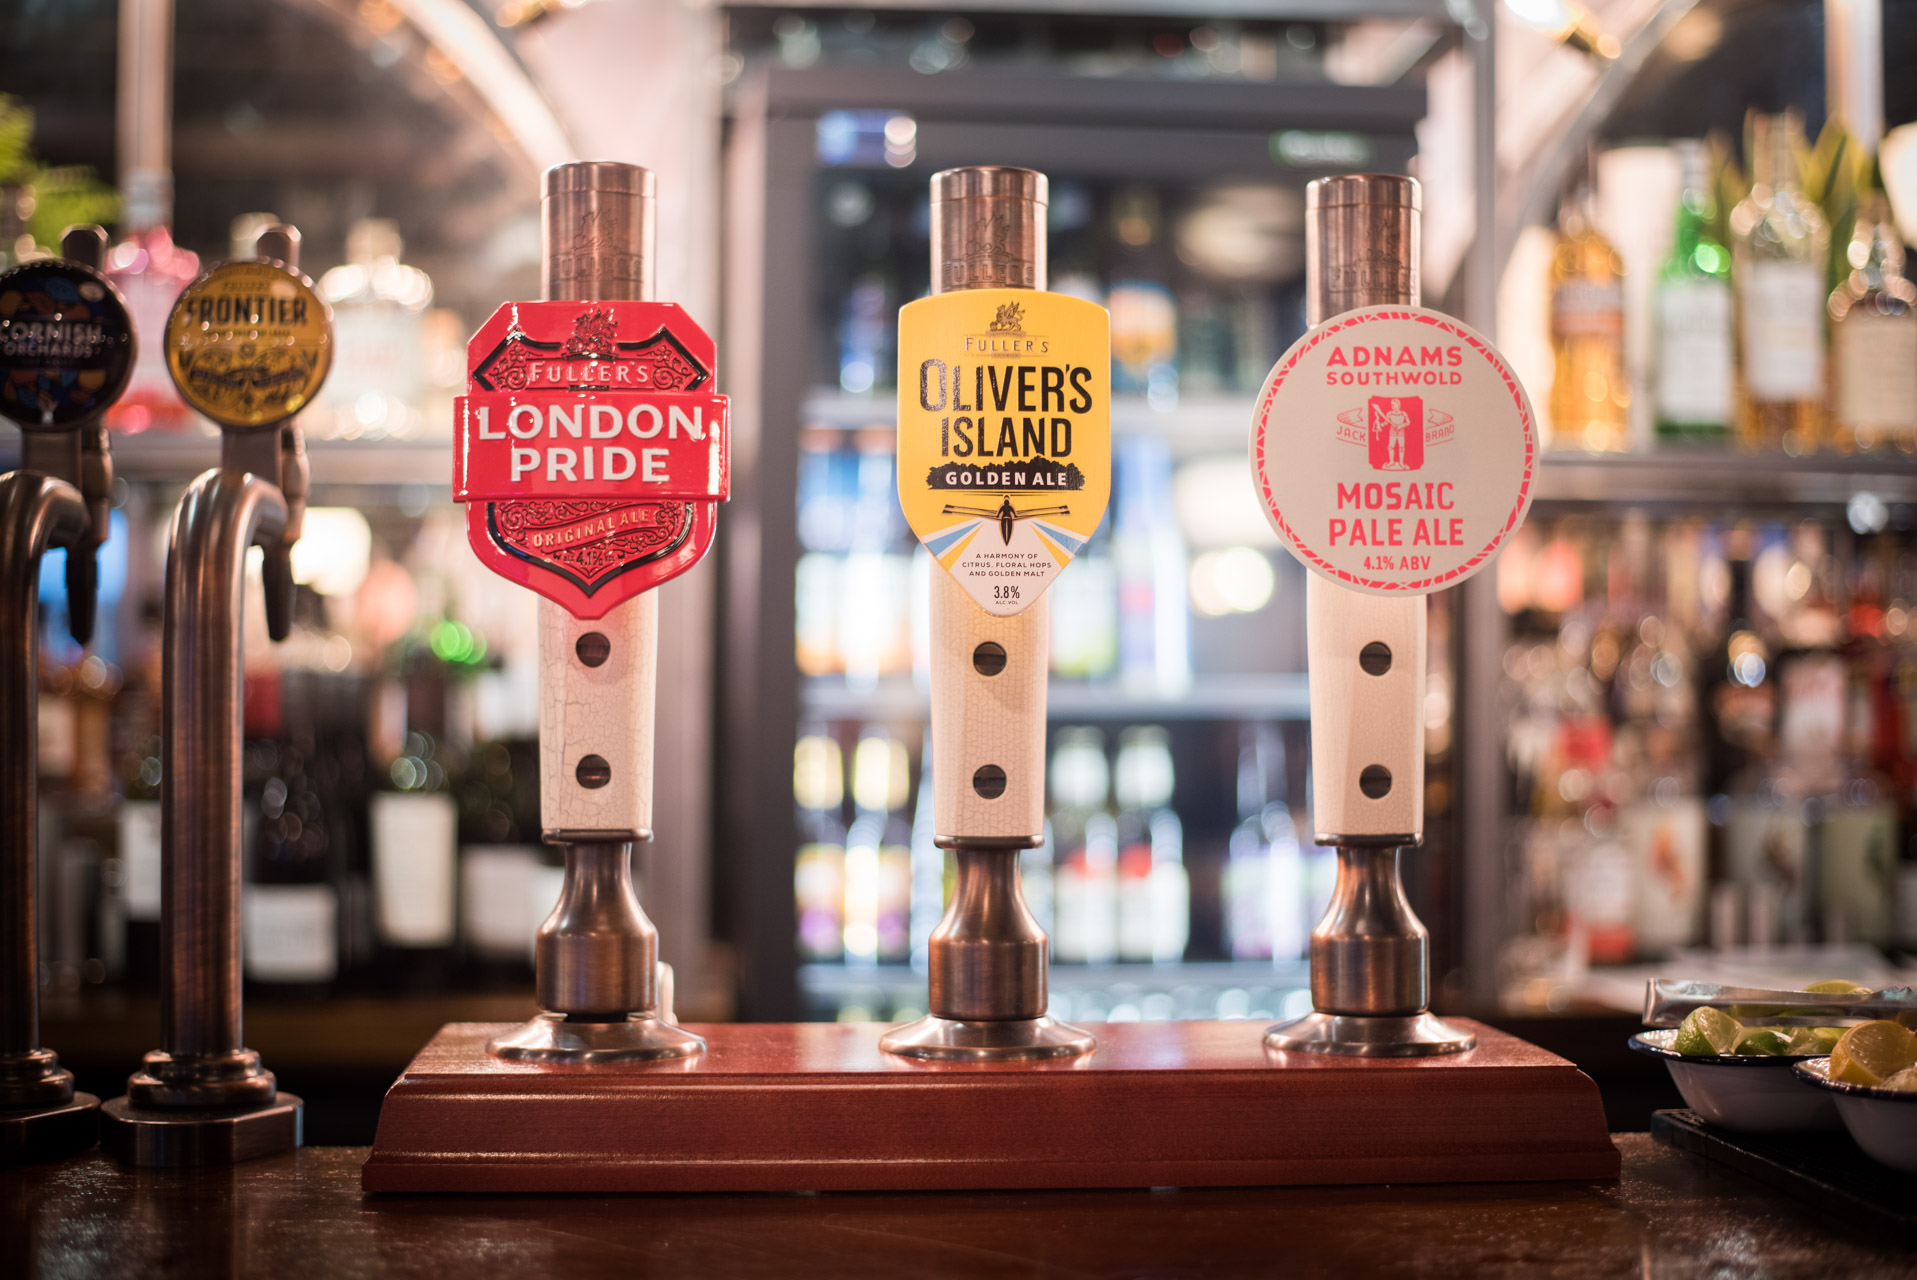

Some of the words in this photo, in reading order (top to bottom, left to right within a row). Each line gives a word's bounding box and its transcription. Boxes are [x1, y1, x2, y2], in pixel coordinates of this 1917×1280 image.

[186, 295, 307, 326] FRONTIER
[965, 336, 1049, 353] FULLER'S
[1326, 346, 1463, 367] ADNAMS
[919, 358, 1093, 414] OLIVER'S
[1326, 371, 1463, 386] SOUTHWOLD
[478, 404, 703, 441] LONDON
[941, 416, 1072, 458] ISLAND
[1336, 425, 1367, 443] JACK
[1425, 424, 1455, 443] BRAND
[511, 446, 671, 483] PRIDE
[945, 471, 1027, 487] GOLDEN
[1032, 472, 1068, 487] ALE
[1336, 482, 1455, 511] MOSAIC
[533, 516, 616, 547] ORIGINAL
[620, 509, 650, 527] ALE
[1328, 518, 1403, 547] PALE
[1412, 518, 1464, 547] ALE
[576, 551, 604, 566] 4.1%
[1363, 556, 1395, 571] 4.1%
[1399, 556, 1432, 571] ABV
[993, 585, 1021, 600] 3.8%
